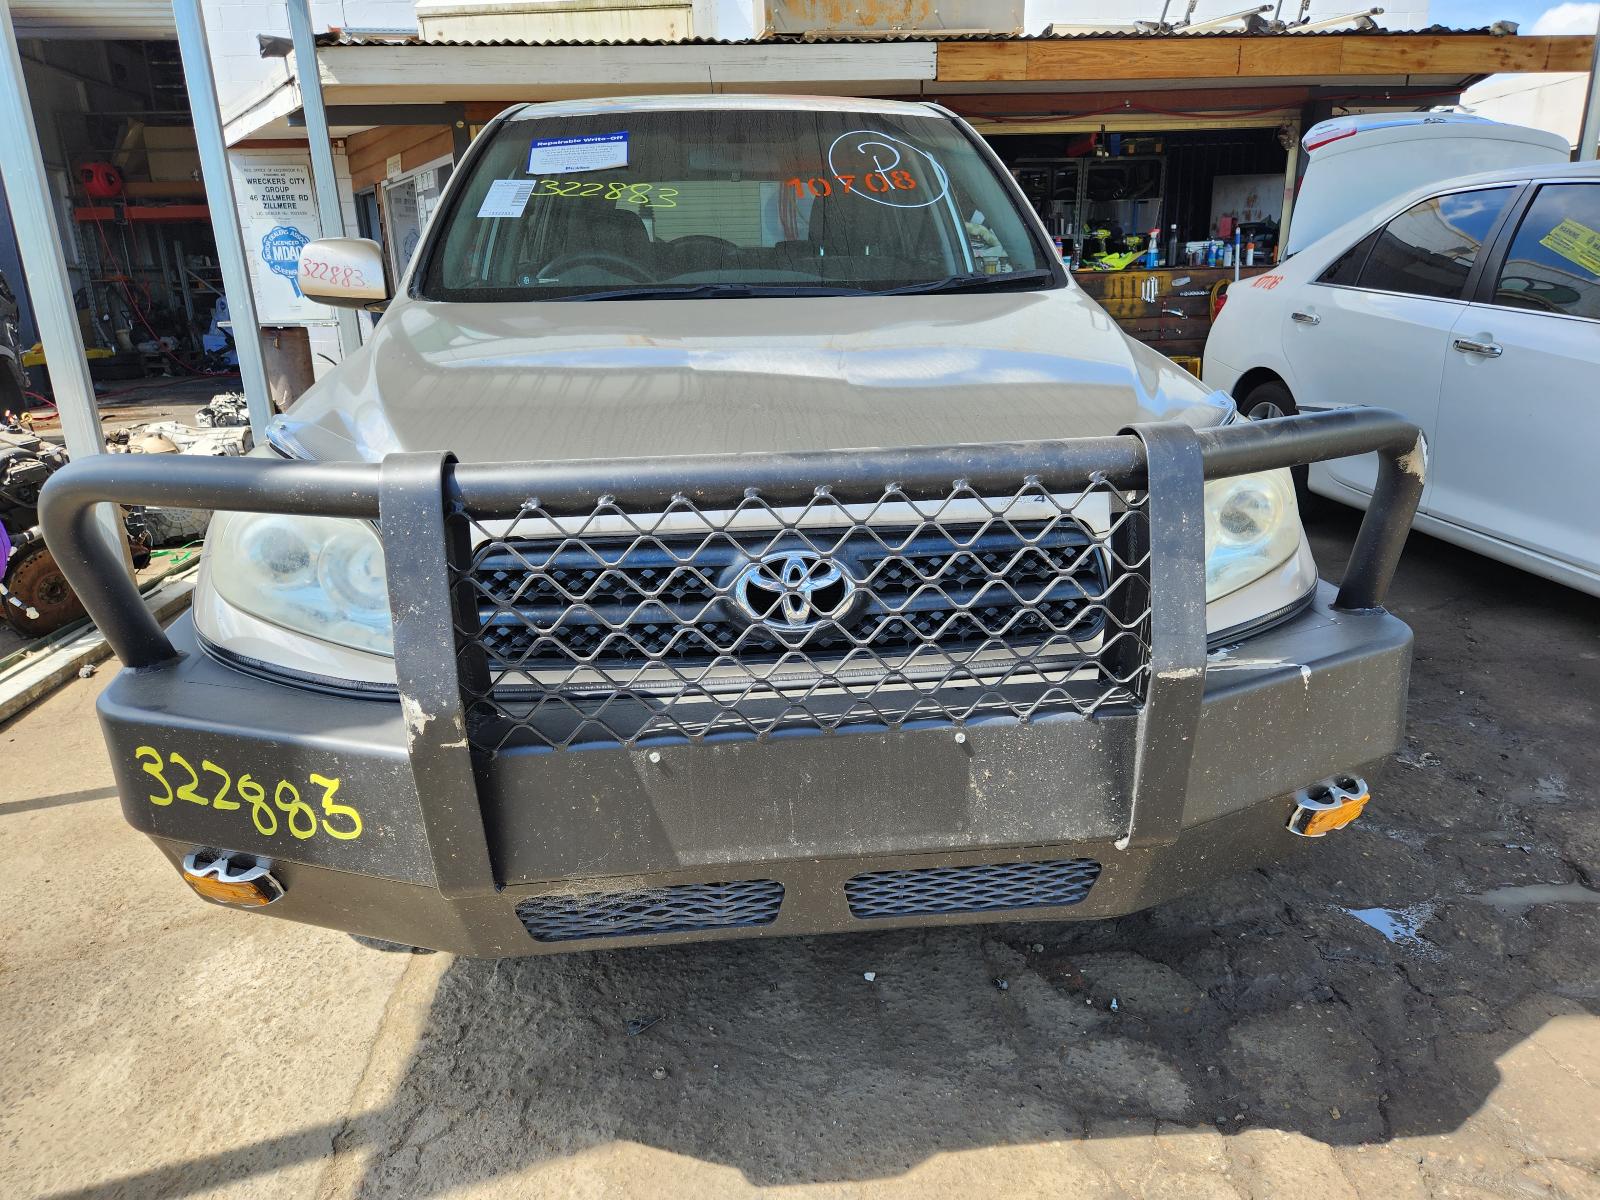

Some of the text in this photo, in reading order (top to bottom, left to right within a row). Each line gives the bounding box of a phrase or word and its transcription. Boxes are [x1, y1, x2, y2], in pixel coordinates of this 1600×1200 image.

[537, 135, 624, 147] Repairable Write-Off
[289, 177, 305, 185] CITY
[532, 179, 679, 208] 322883
[785, 170, 917, 198] 10708
[263, 202, 298, 210] ZILLMERE
[304, 258, 366, 288] 322883
[135, 746, 362, 840] 322883
